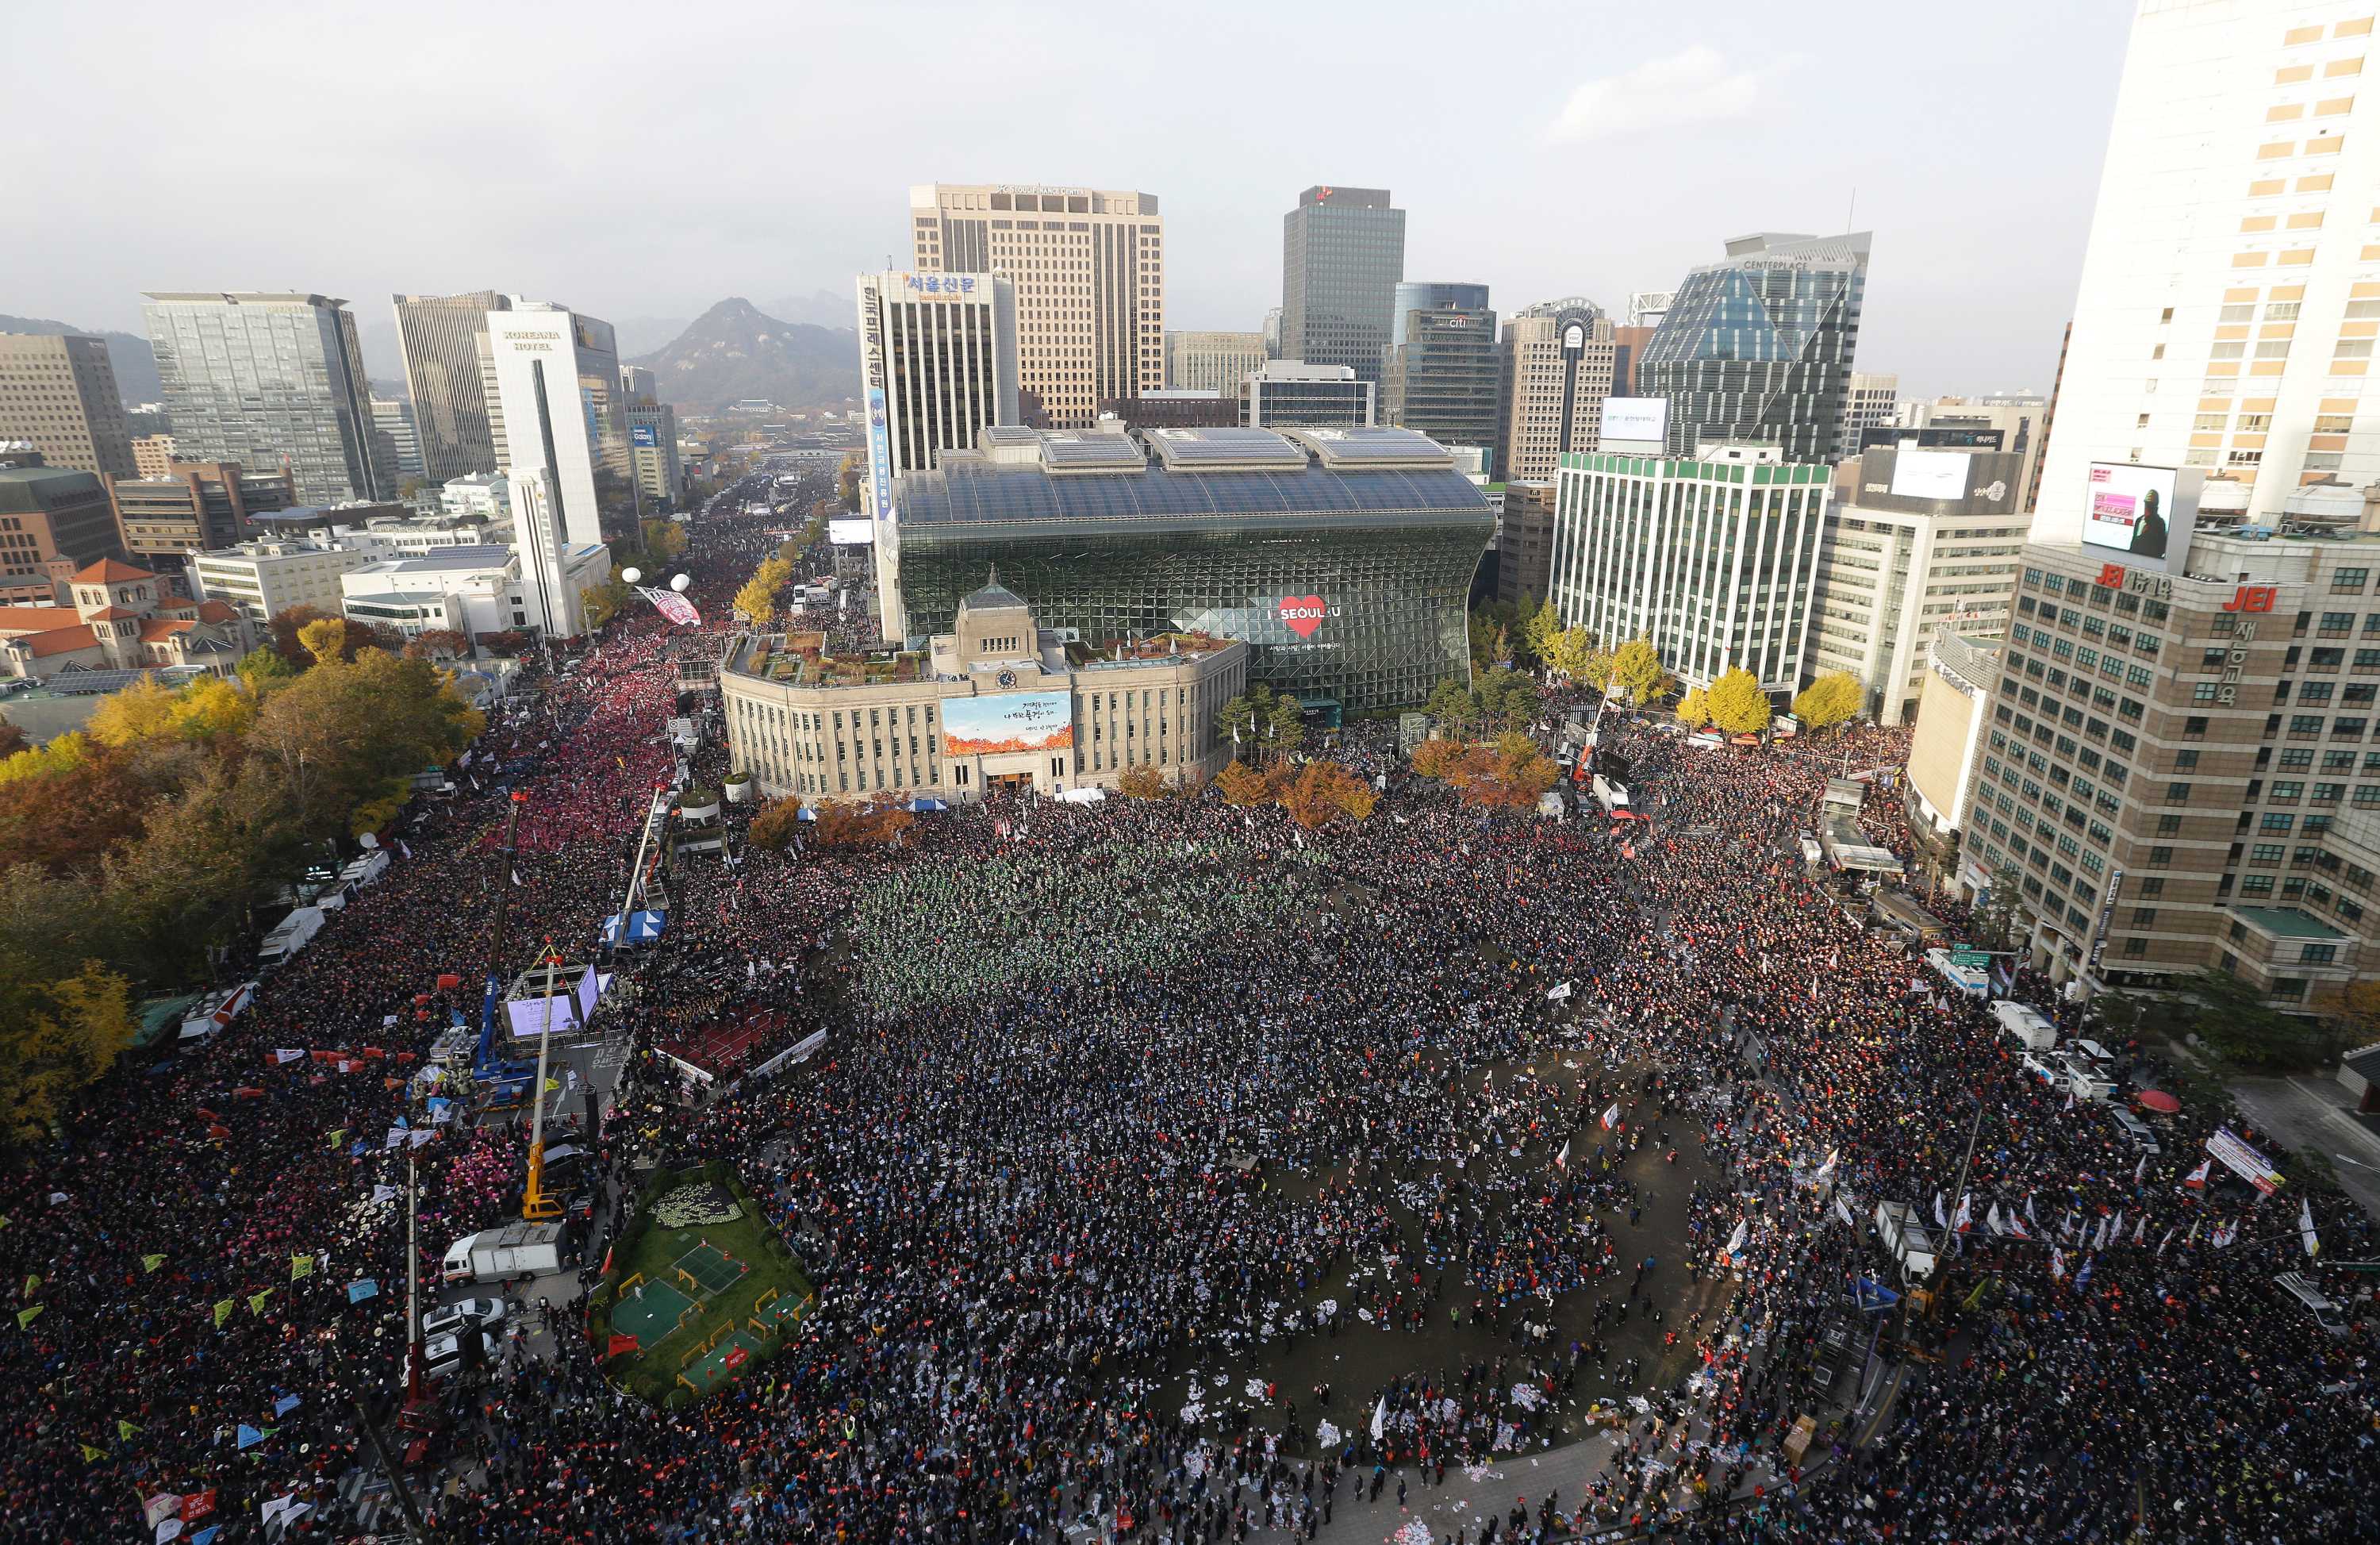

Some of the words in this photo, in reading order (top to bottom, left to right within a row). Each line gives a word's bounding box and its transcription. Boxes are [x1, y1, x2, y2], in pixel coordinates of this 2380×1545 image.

[1744, 260, 1808, 270] CENTERPLACE
[908, 276, 975, 293] 서울신문
[1449, 317, 1466, 328] citi
[505, 331, 560, 340] KOREANA
[514, 342, 553, 351] HOTEL
[2095, 563, 2125, 589] JEI
[2222, 586, 2277, 612] JEI
[1280, 607, 1324, 619] SEOUL
[2217, 621, 2257, 707] 재능교육
